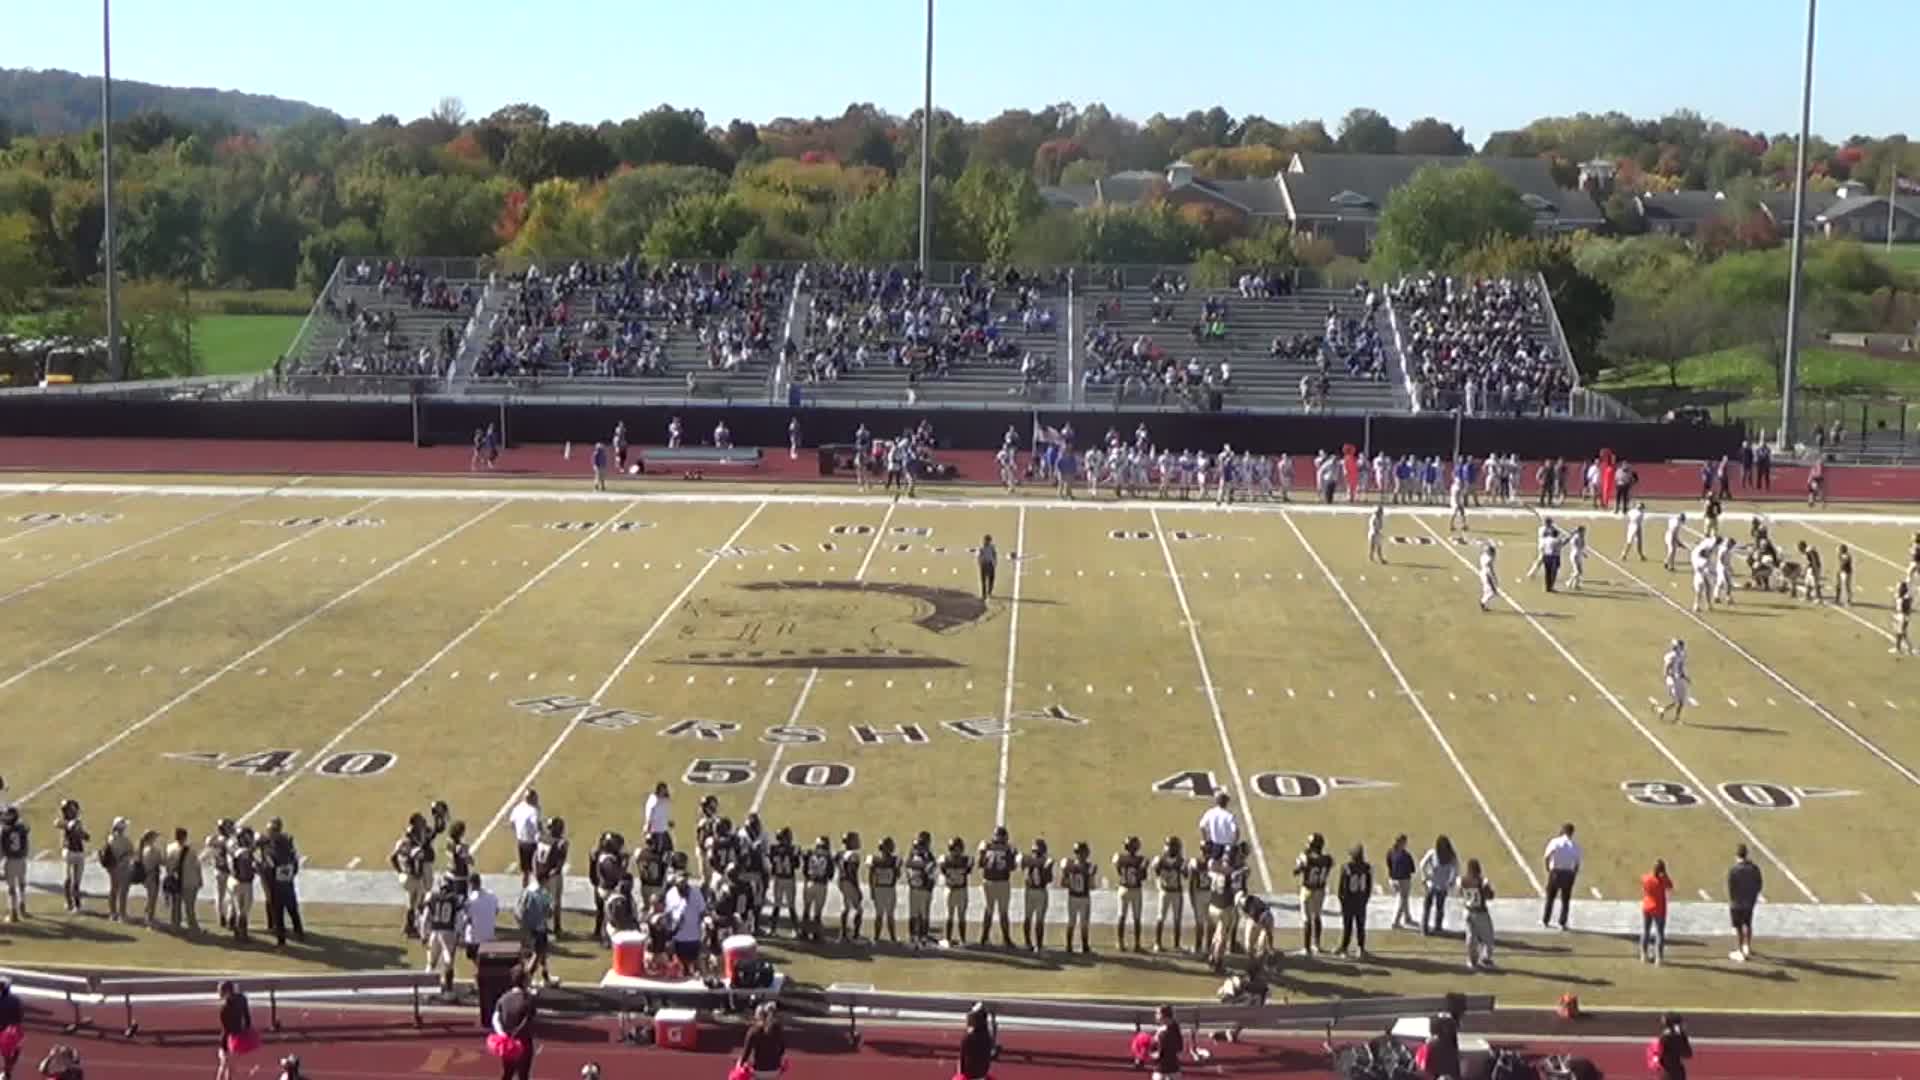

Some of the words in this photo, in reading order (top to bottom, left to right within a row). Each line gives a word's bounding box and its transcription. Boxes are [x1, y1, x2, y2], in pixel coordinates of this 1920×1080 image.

[511, 696, 1089, 745] HERSHEY
[220, 750, 398, 776] 40
[682, 757, 856, 788] 50
[1152, 769, 1328, 800] 40
[1620, 780, 1800, 809] 30
